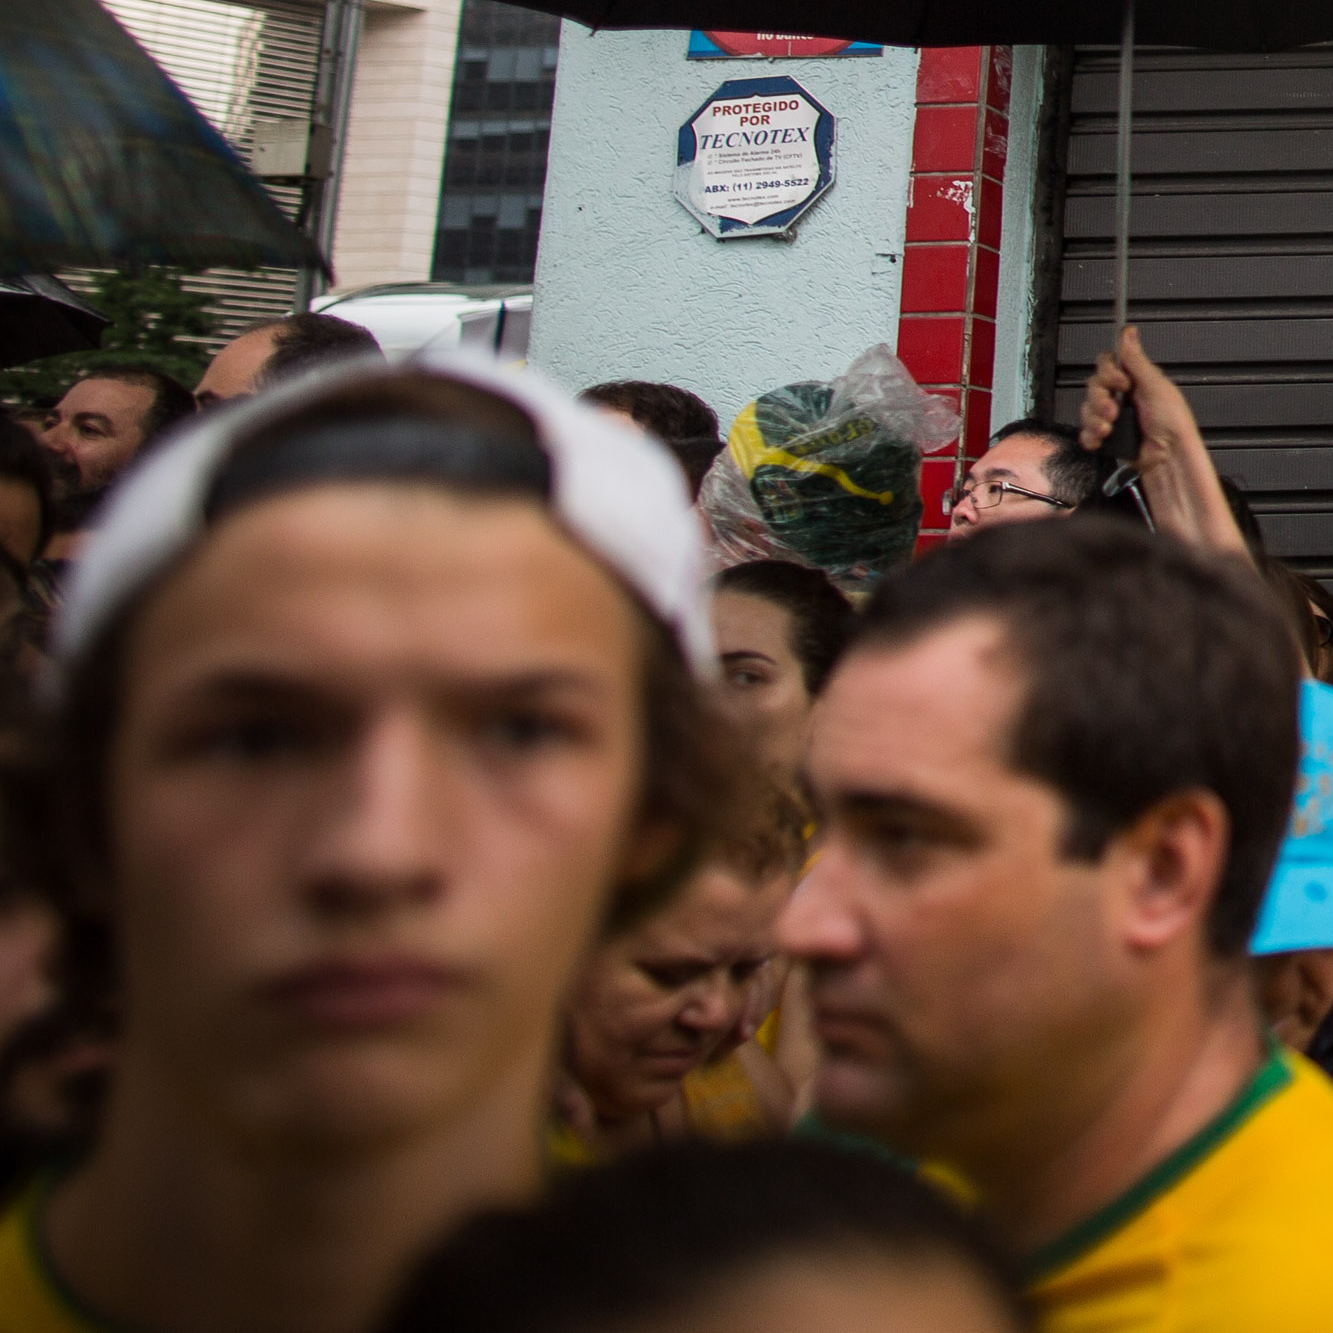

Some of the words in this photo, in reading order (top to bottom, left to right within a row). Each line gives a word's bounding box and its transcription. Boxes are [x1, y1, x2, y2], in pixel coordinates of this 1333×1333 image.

[712, 99, 800, 117] PROTEGIDO
[740, 114, 771, 127] POR
[700, 126, 811, 150] TECNOTEX
[732, 182, 753, 192] (11)
